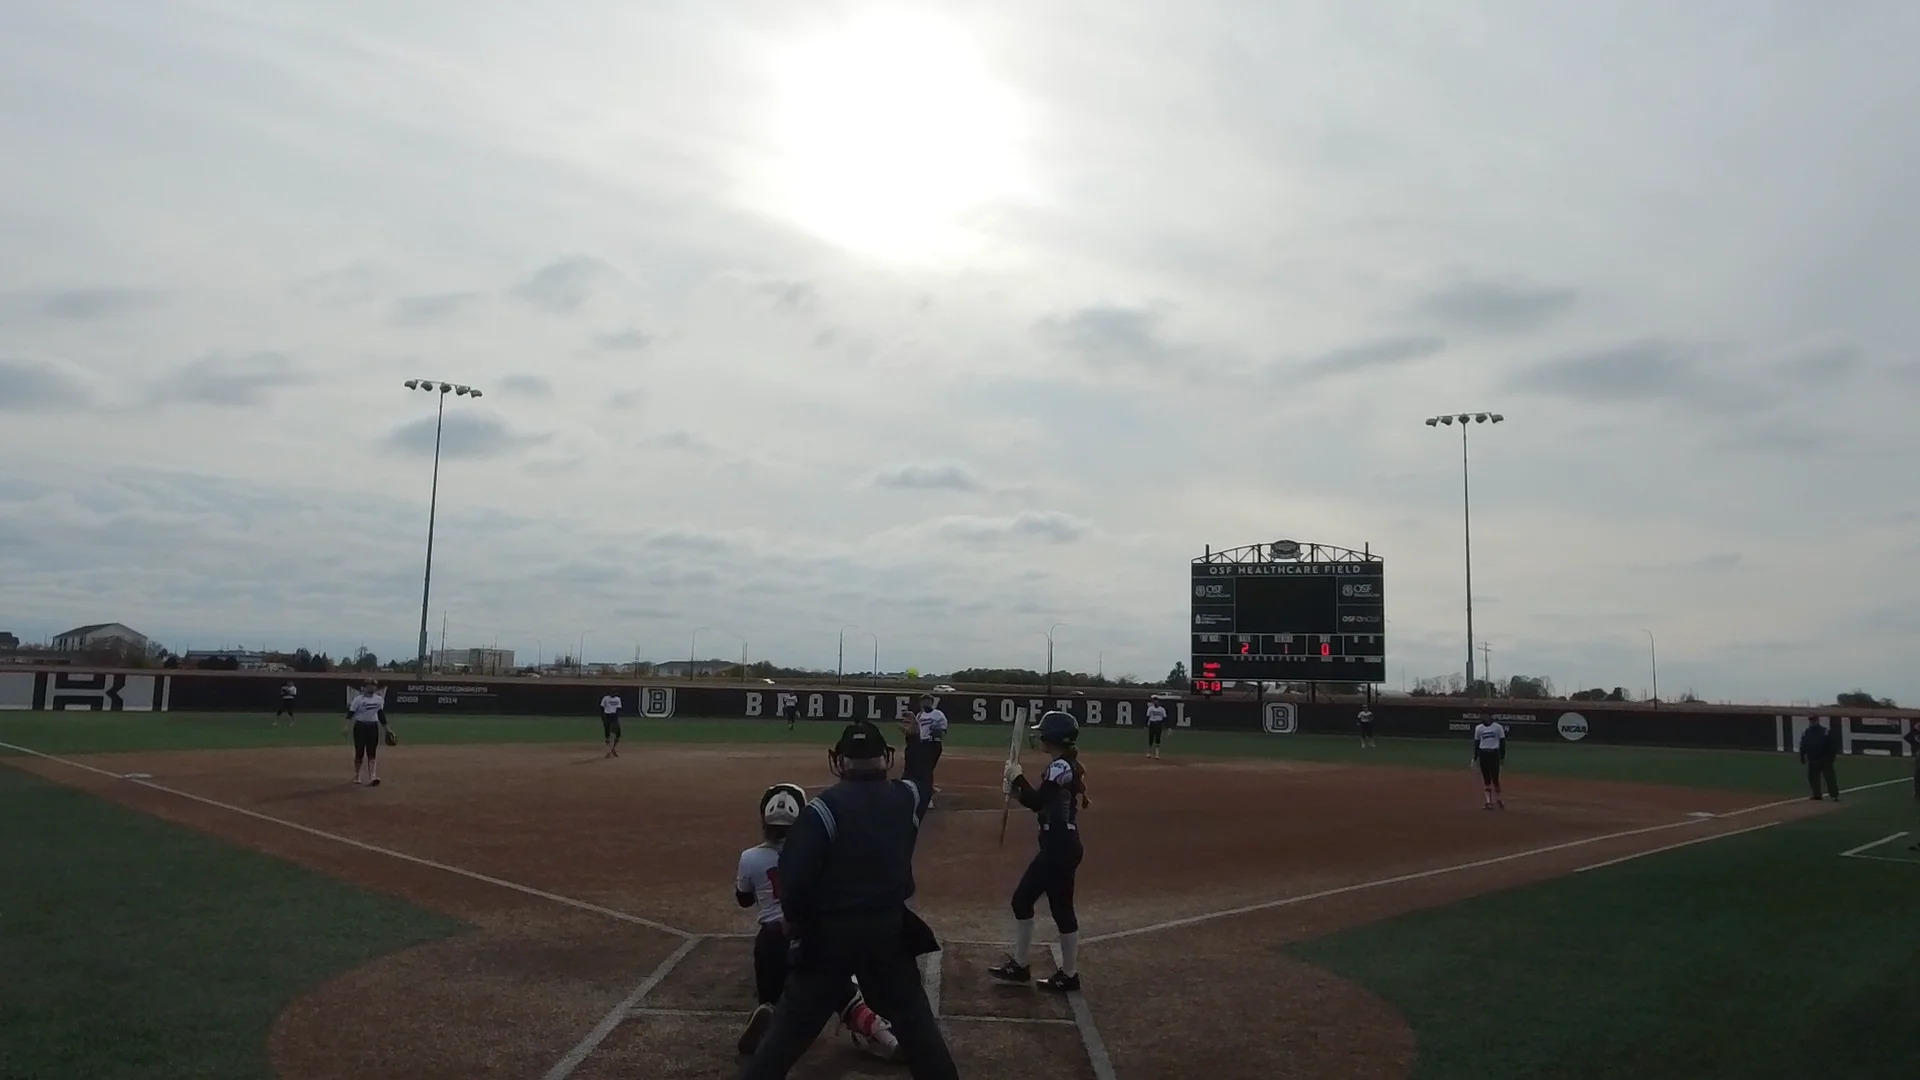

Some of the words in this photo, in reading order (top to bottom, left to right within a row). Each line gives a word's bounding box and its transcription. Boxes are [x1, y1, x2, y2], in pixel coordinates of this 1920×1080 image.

[1209, 566, 1232, 575] OSF
[1238, 565, 1318, 574] HEALTHCARE
[1324, 565, 1361, 573] FIELD
[1241, 643, 1249, 655] 2
[1321, 643, 1330, 656] 0
[745, 692, 941, 719] BRADLE
[973, 699, 1191, 727] SOFTBAL
